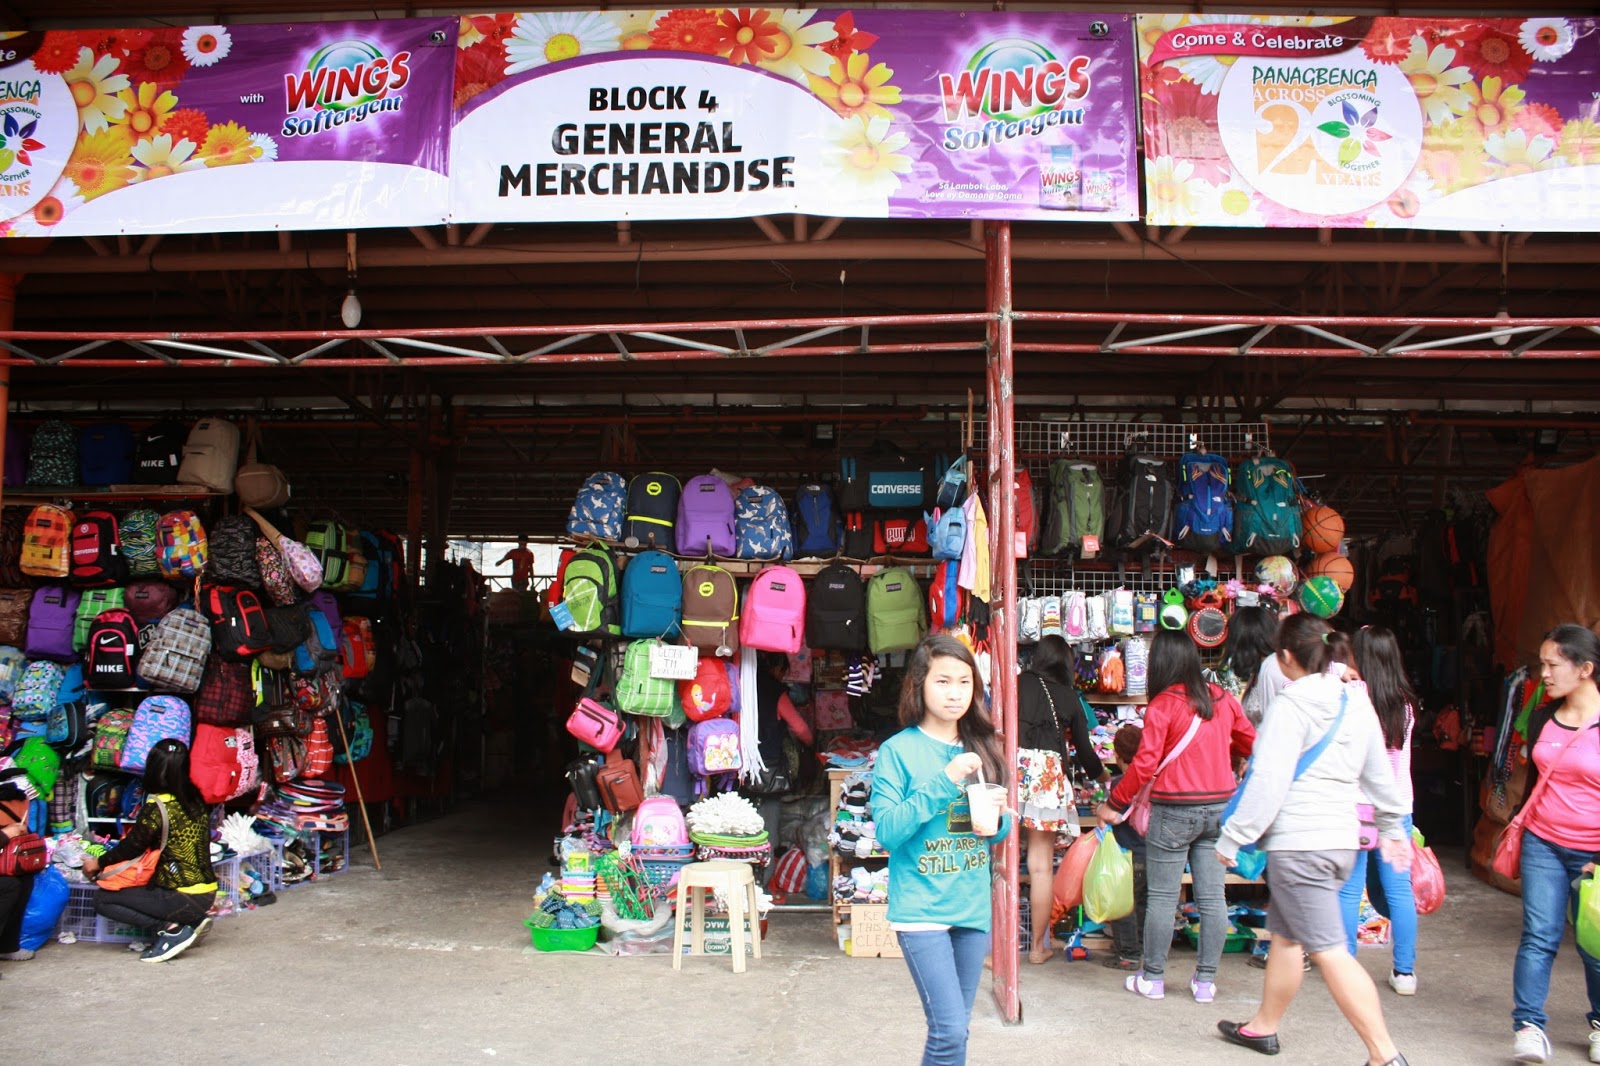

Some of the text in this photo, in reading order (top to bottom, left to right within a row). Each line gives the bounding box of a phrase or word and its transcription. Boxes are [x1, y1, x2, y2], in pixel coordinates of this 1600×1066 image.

[1172, 31, 1344, 50] Come & Celebrate
[284, 51, 412, 115] WINGS
[1252, 65, 1378, 88] PANAGBENGA
[939, 56, 1091, 123] WINGS
[1253, 87, 1327, 103] ACROSS
[240, 93, 264, 104] with
[588, 86, 719, 113] BLOCK 4
[1327, 92, 1382, 107] BLOSSOMING
[0, 106, 42, 119] OSSOMING
[282, 96, 404, 137] Softergent
[943, 106, 1086, 151] Softergent
[551, 121, 743, 155] GENERAL
[1340, 160, 1381, 171] TOGETHER
[498, 156, 797, 197] MERCHANDISE
[1041, 170, 1081, 187] WINGS
[925, 190, 945, 199] Love
[871, 485, 921, 494] CONVERSE
[96, 664, 124, 672] NIKE
[863, 911, 887, 921] KEE
[855, 934, 898, 948] CLEA
